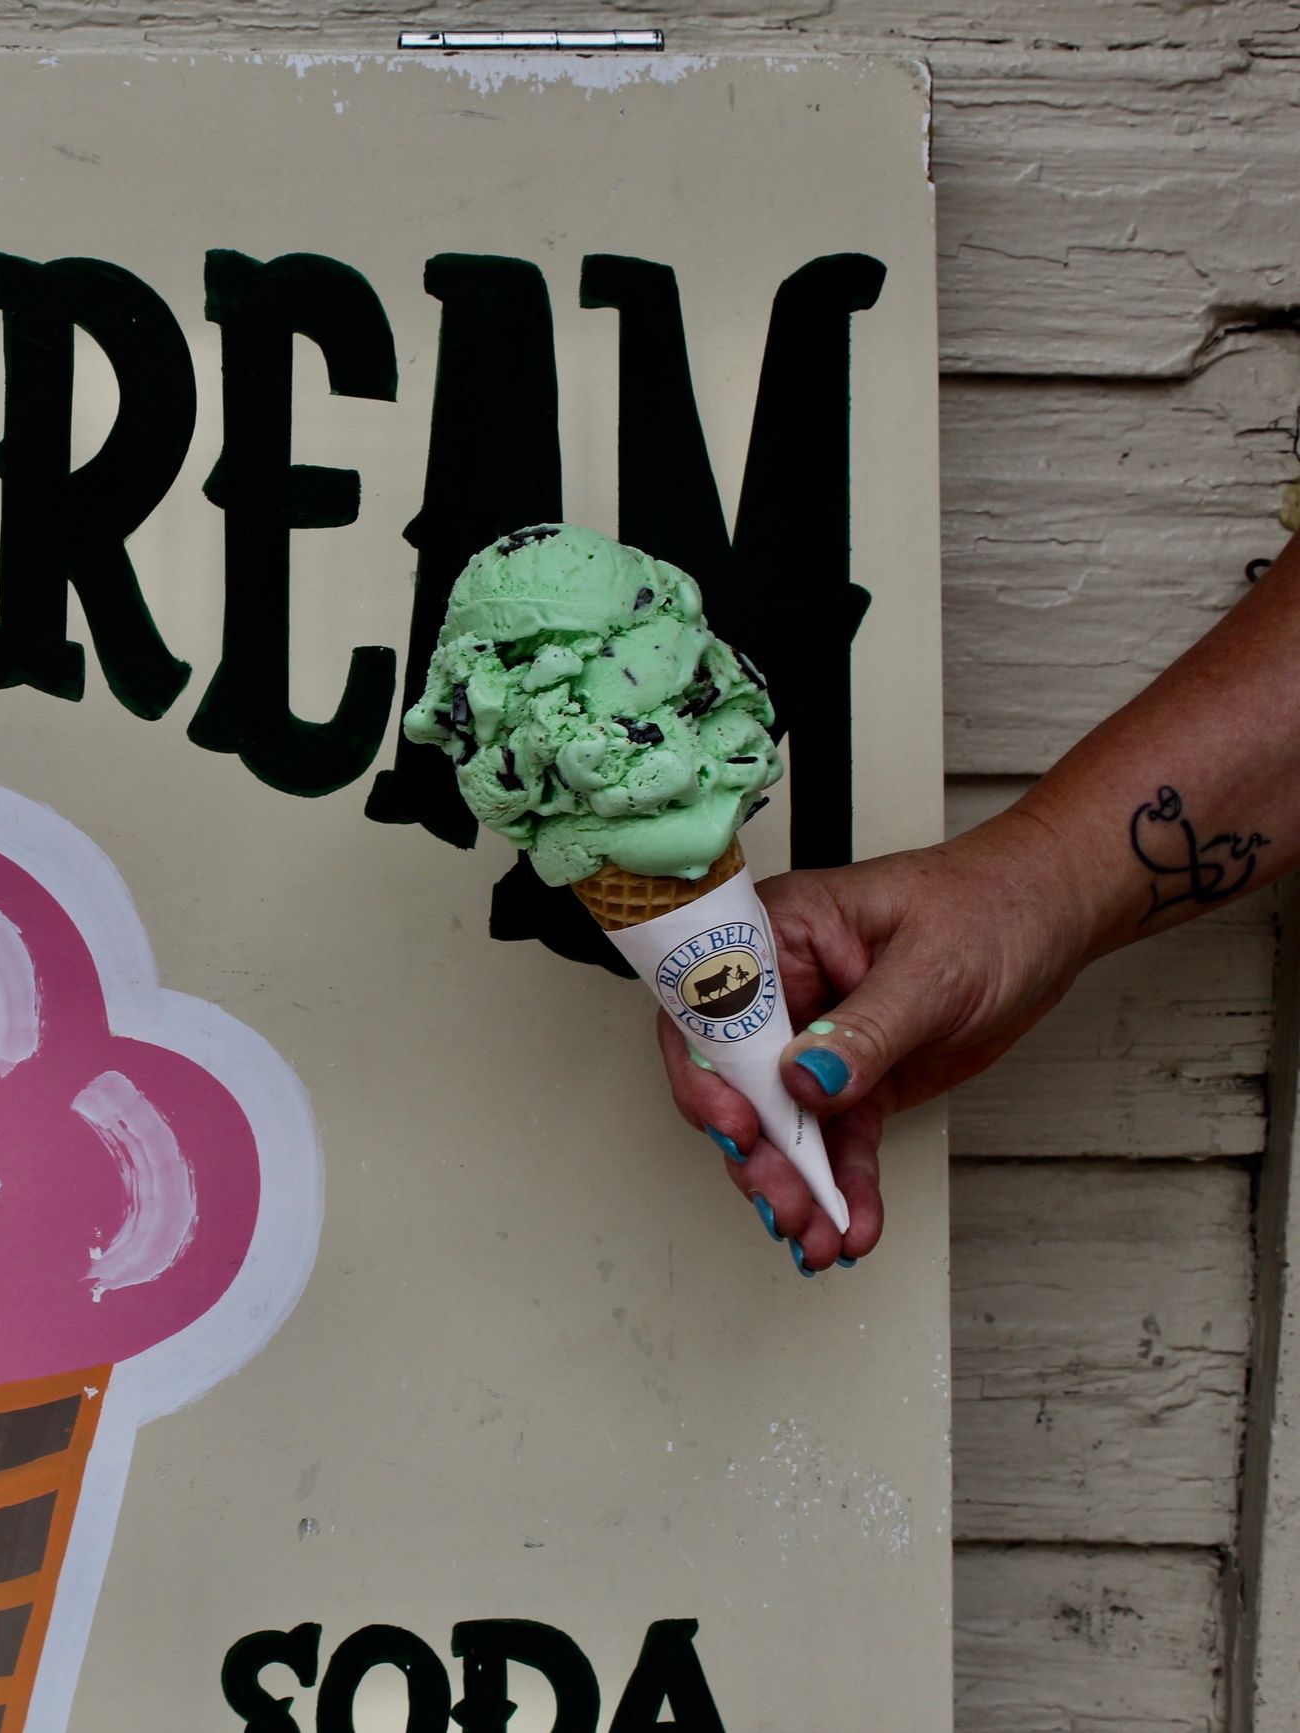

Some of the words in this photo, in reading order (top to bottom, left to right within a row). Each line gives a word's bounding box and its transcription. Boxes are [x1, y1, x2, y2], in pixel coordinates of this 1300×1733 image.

[659, 940, 705, 990] BLUE
[707, 925, 756, 950] BELL
[677, 1009, 715, 1038] ICE
[723, 968, 776, 1040] CREAM
